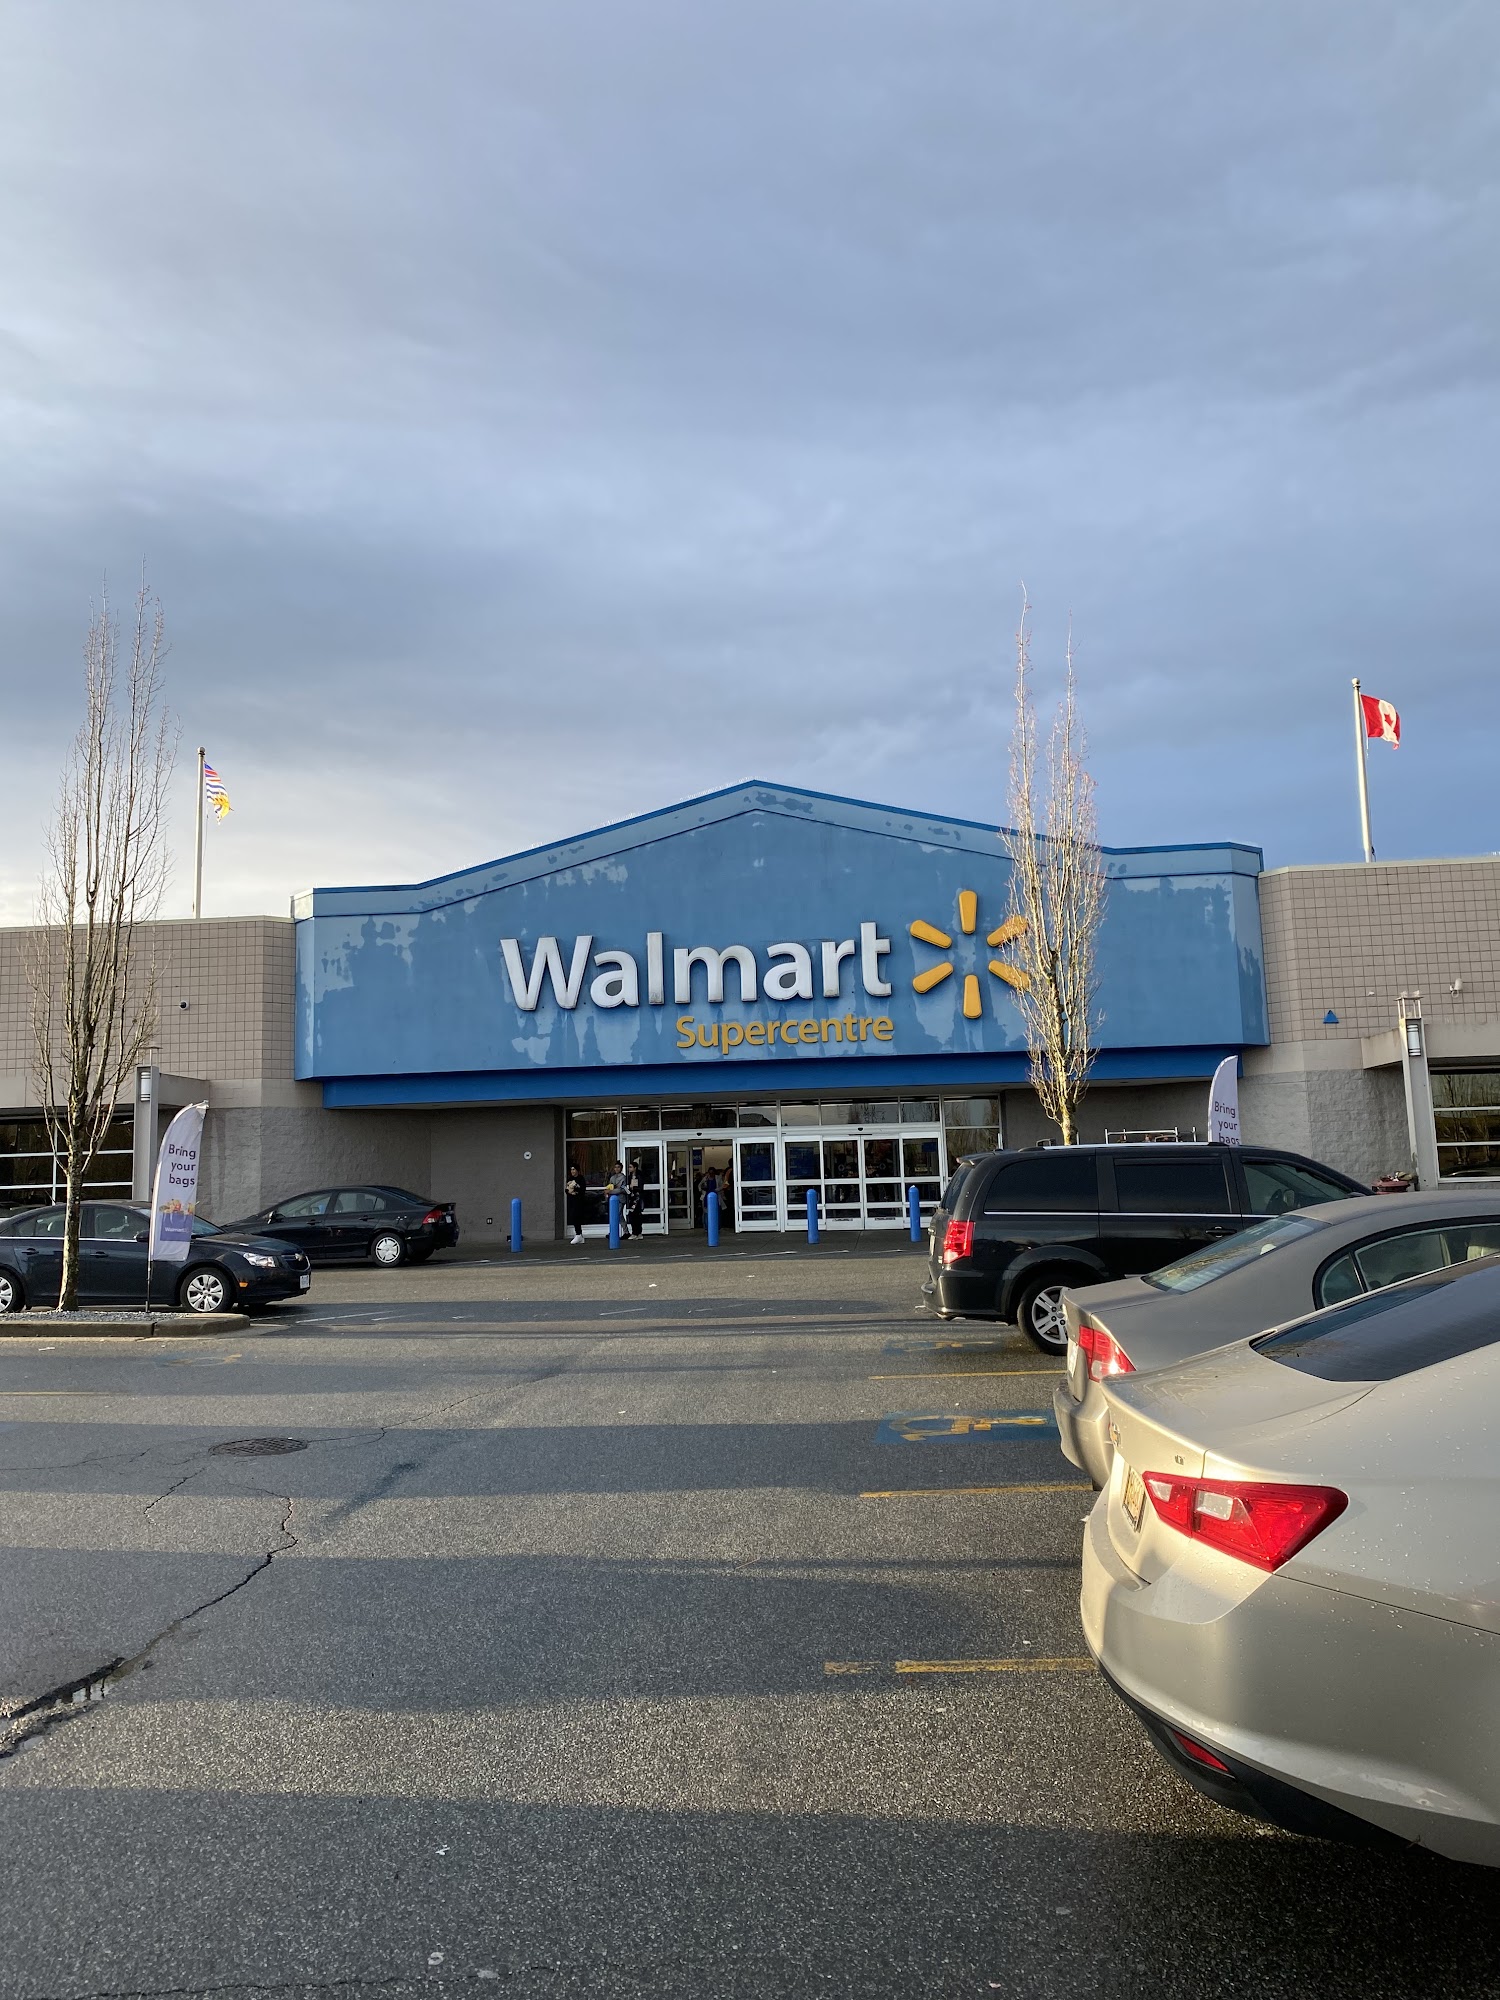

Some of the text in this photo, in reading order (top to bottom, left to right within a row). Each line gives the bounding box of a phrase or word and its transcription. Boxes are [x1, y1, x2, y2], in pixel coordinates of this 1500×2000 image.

[500, 920, 892, 1011] Walmart
[676, 1013, 894, 1055] Supercentre
[1214, 1101, 1235, 1118] Bring
[1218, 1120, 1238, 1131] your
[168, 1143, 196, 1160] Bring
[171, 1161, 197, 1173] your
[168, 1173, 196, 1188] bags
